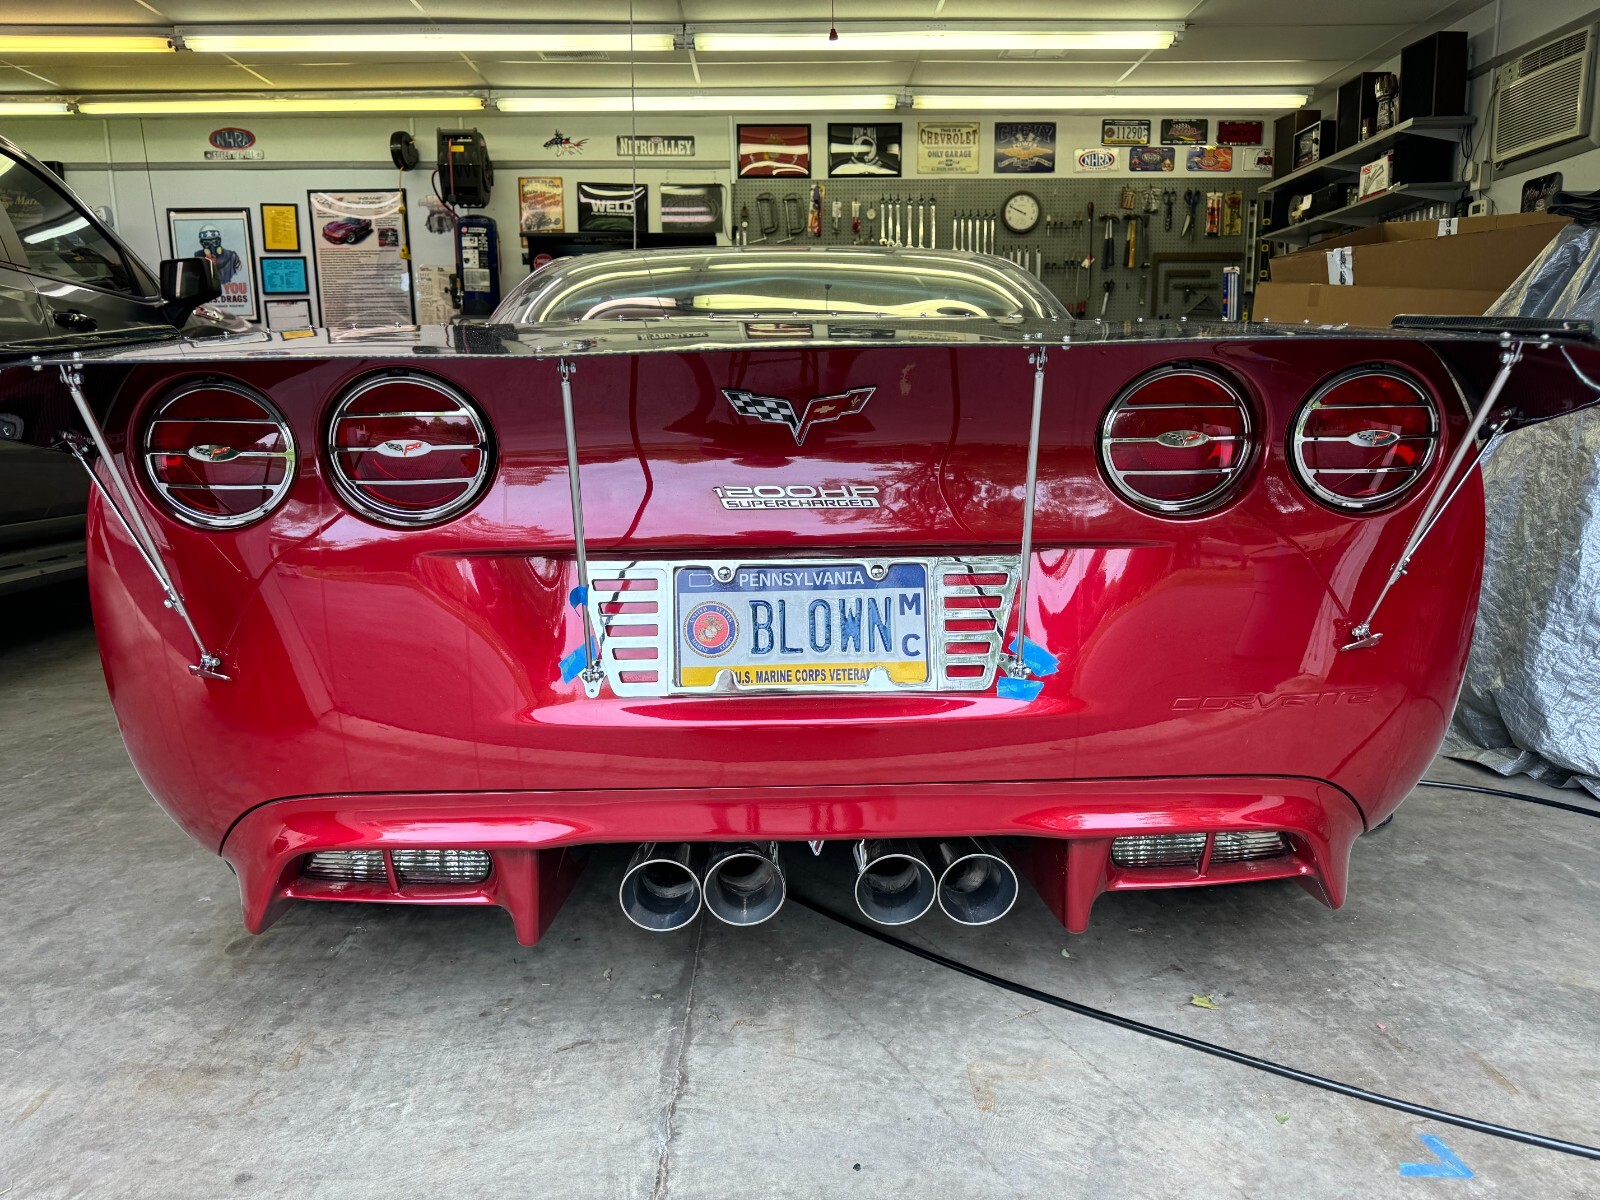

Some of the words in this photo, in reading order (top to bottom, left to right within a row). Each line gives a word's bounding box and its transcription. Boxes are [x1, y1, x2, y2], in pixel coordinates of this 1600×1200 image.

[216, 132, 249, 147] NHRA
[921, 129, 978, 145] CHEVROLET
[998, 125, 1054, 143] CHEVY
[1117, 127, 1142, 139] 11290
[620, 138, 655, 155] NITRO
[657, 140, 692, 155] ALLEY
[1084, 153, 1110, 167] NHRA
[591, 200, 633, 213] WELD
[223, 283, 247, 294] YOU
[221, 295, 248, 303] DRAGS
[712, 485, 880, 498] 1200HP
[726, 499, 874, 508] SUPERCHARGED
[739, 571, 865, 587] PENNSYLVANIA
[748, 596, 893, 655] BLOWN
[735, 670, 753, 684] U.S.
[756, 670, 792, 684] MARINE
[795, 668, 826, 683] CORPS
[1169, 686, 1379, 711] CORVETTE
